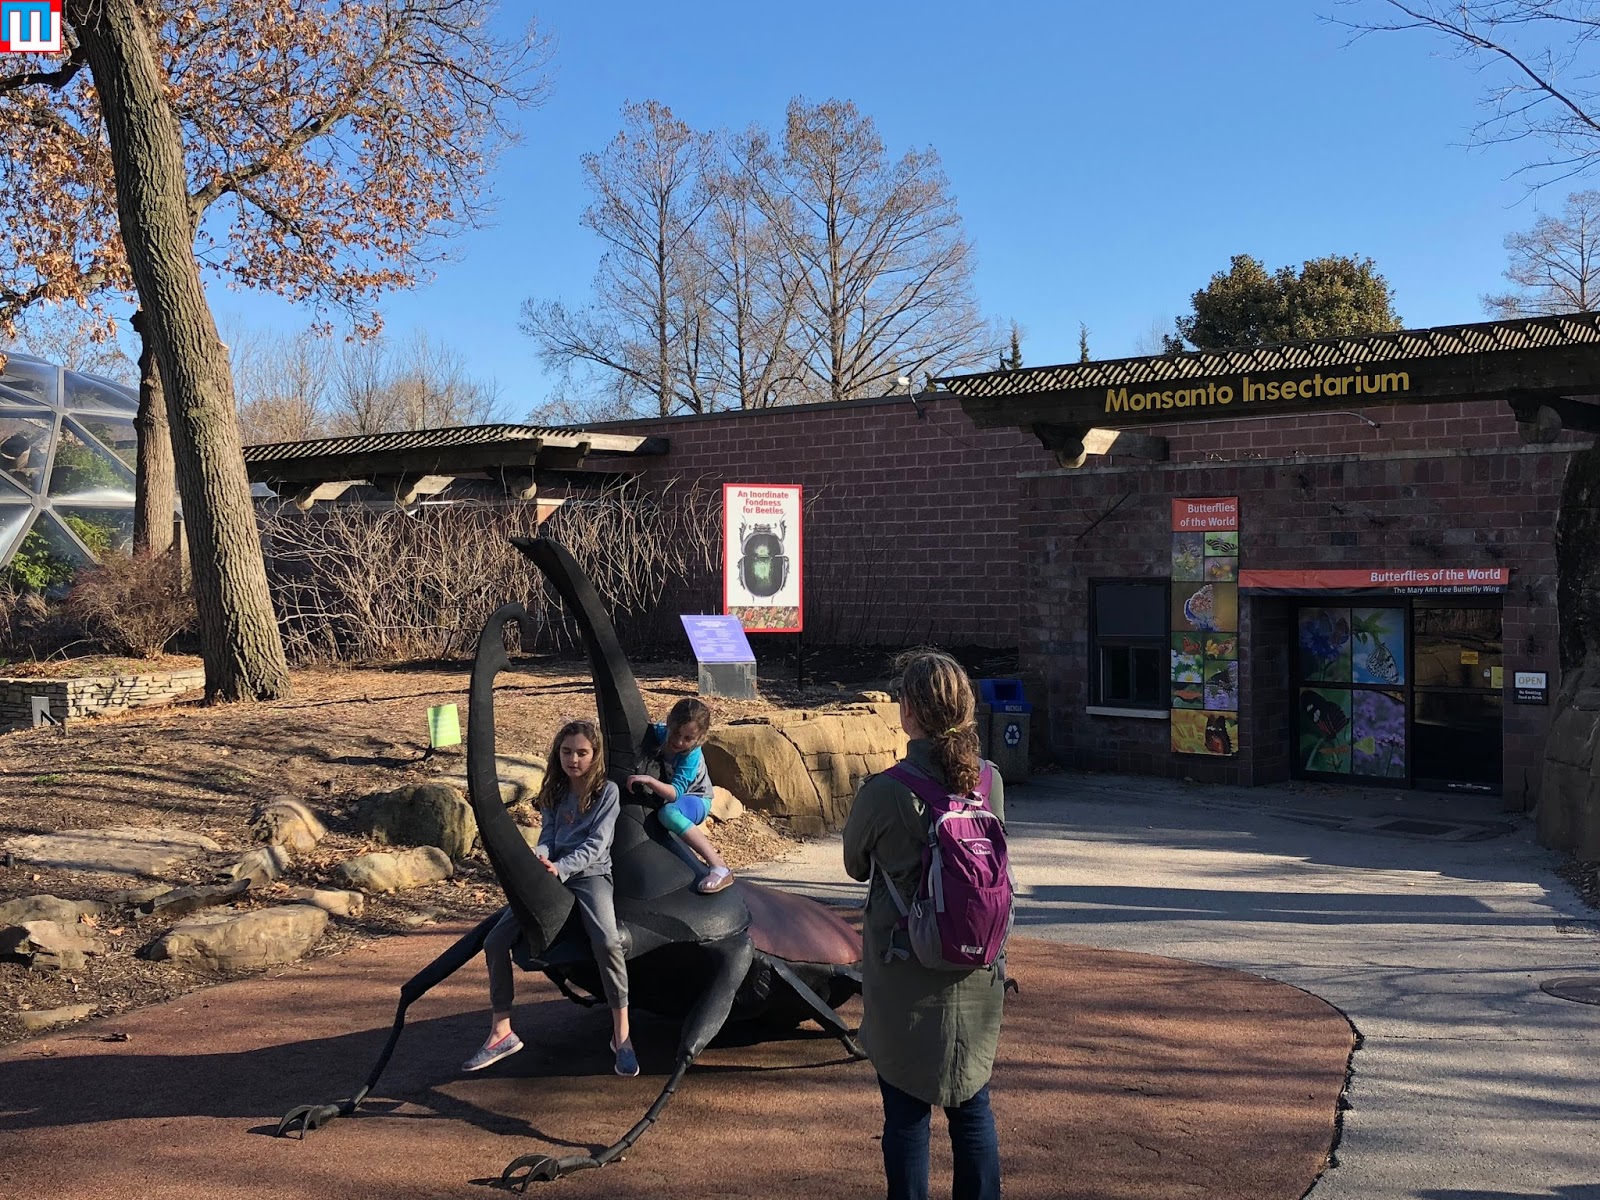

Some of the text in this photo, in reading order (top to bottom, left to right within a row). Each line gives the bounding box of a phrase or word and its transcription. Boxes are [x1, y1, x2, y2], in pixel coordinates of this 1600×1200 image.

[1104, 366, 1410, 413] Monsanto Insectarium
[750, 490, 788, 498] Inordinate
[755, 506, 784, 514] Beetles
[1187, 503, 1236, 513] Butterflies
[1180, 516, 1235, 527] of the World
[1370, 568, 1501, 582] Butterflies of the World
[1407, 586, 1424, 595] Mary
[1440, 585, 1452, 593] Lee
[1453, 585, 1482, 594] Butterfly
[1482, 585, 1500, 593] Wing
[1518, 676, 1542, 685] OPEN
